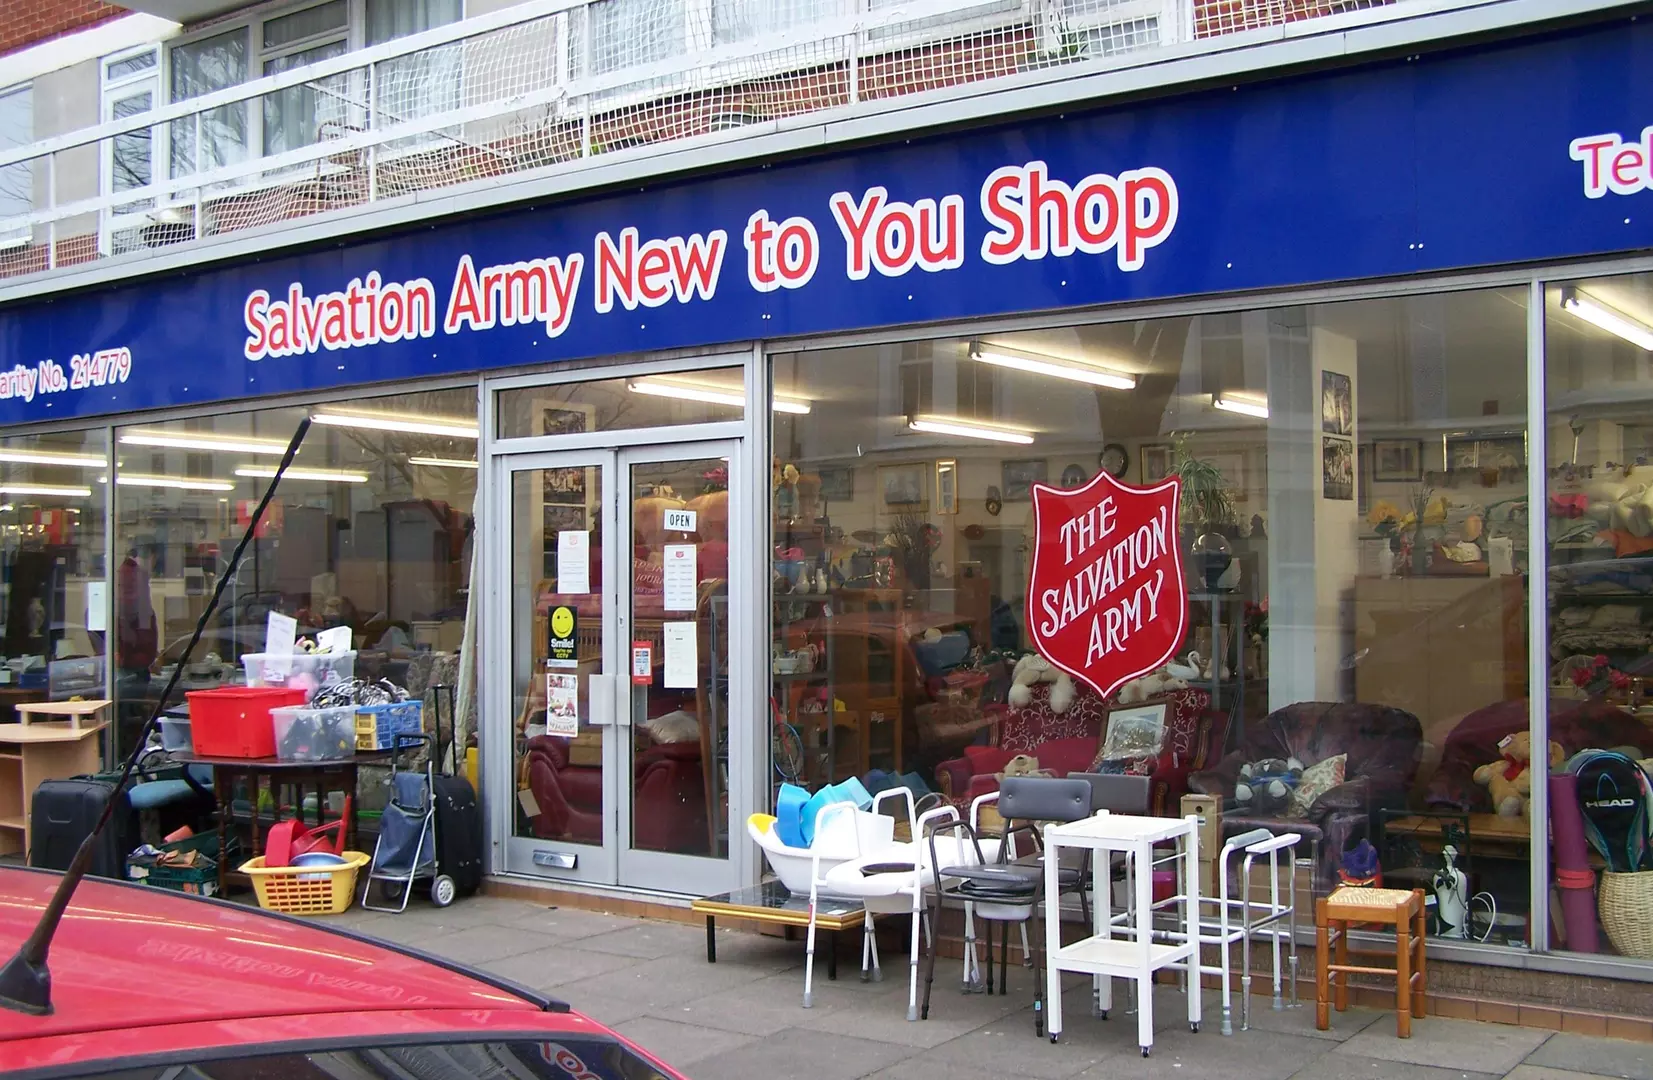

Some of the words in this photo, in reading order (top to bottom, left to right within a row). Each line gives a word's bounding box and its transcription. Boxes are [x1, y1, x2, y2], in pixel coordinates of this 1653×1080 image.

[245, 270, 435, 360] Salvation
[444, 254, 584, 338] Army
[594, 226, 727, 312] New
[744, 209, 819, 292] to
[829, 186, 964, 280] You
[980, 160, 1178, 272] Shop
[39, 359, 68, 394] No.
[70, 346, 131, 390] 214779
[669, 513, 690, 527] OPEN
[1059, 495, 1118, 565] THE
[1041, 505, 1167, 638] SALVATION
[551, 638, 574, 648] Smile!
[1085, 569, 1163, 668] ARMY
[1585, 798, 1634, 807] HEAD
